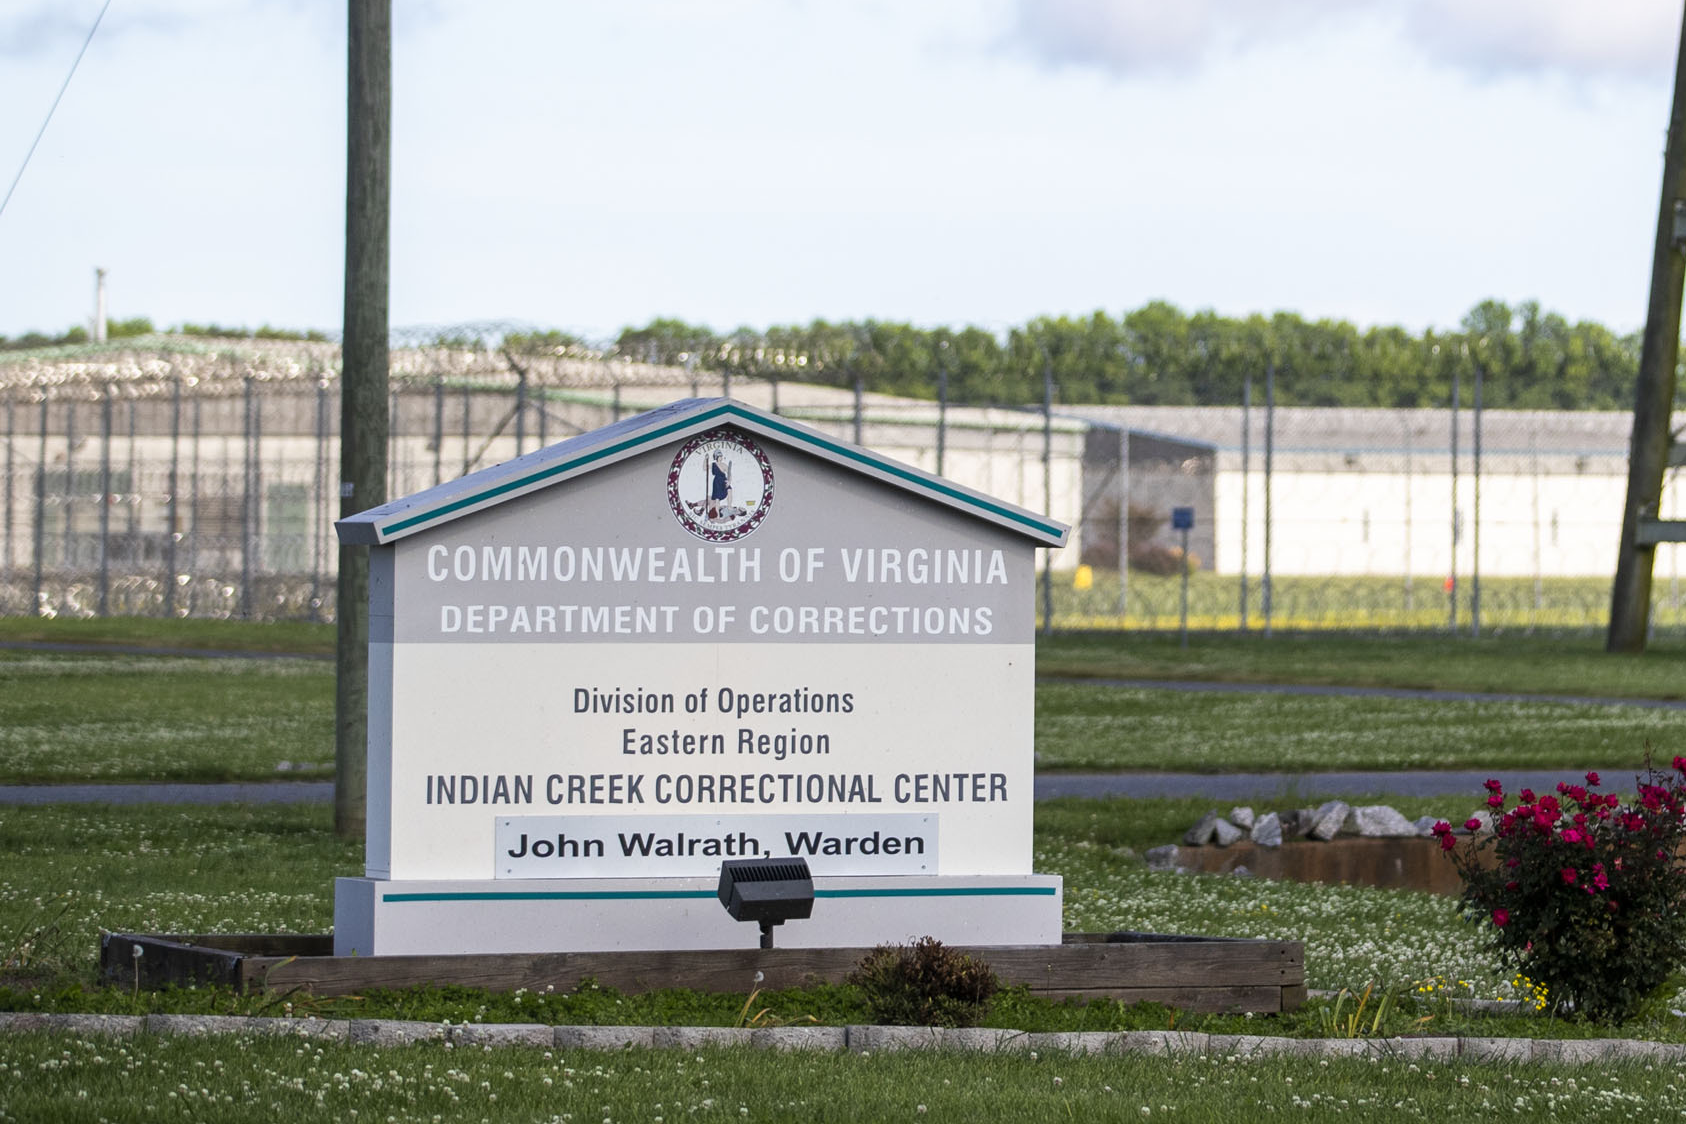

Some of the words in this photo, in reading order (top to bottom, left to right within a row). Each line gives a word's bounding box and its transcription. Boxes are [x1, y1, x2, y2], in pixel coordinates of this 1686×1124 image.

[695, 440, 745, 456] VIRGINIA
[428, 545, 762, 584] COMMONWEALTH
[779, 548, 826, 584] OF
[841, 548, 1009, 586] VIRGINIA
[441, 605, 681, 635] DEPARTMENT
[694, 606, 737, 635] OF
[750, 606, 994, 637] CORRECTIONS
[574, 687, 675, 715] Division
[685, 688, 709, 715] of
[718, 687, 855, 721] Operations
[623, 728, 726, 756] Eastern
[738, 728, 831, 758] Region
[427, 775, 534, 806] INDIAN
[547, 774, 646, 806] CREEK
[656, 773, 883, 806] CORRECTIONAL
[895, 773, 1009, 805] CENTER
[507, 832, 605, 859] John
[618, 831, 772, 860] Walrath,
[785, 830, 926, 857] Warden
